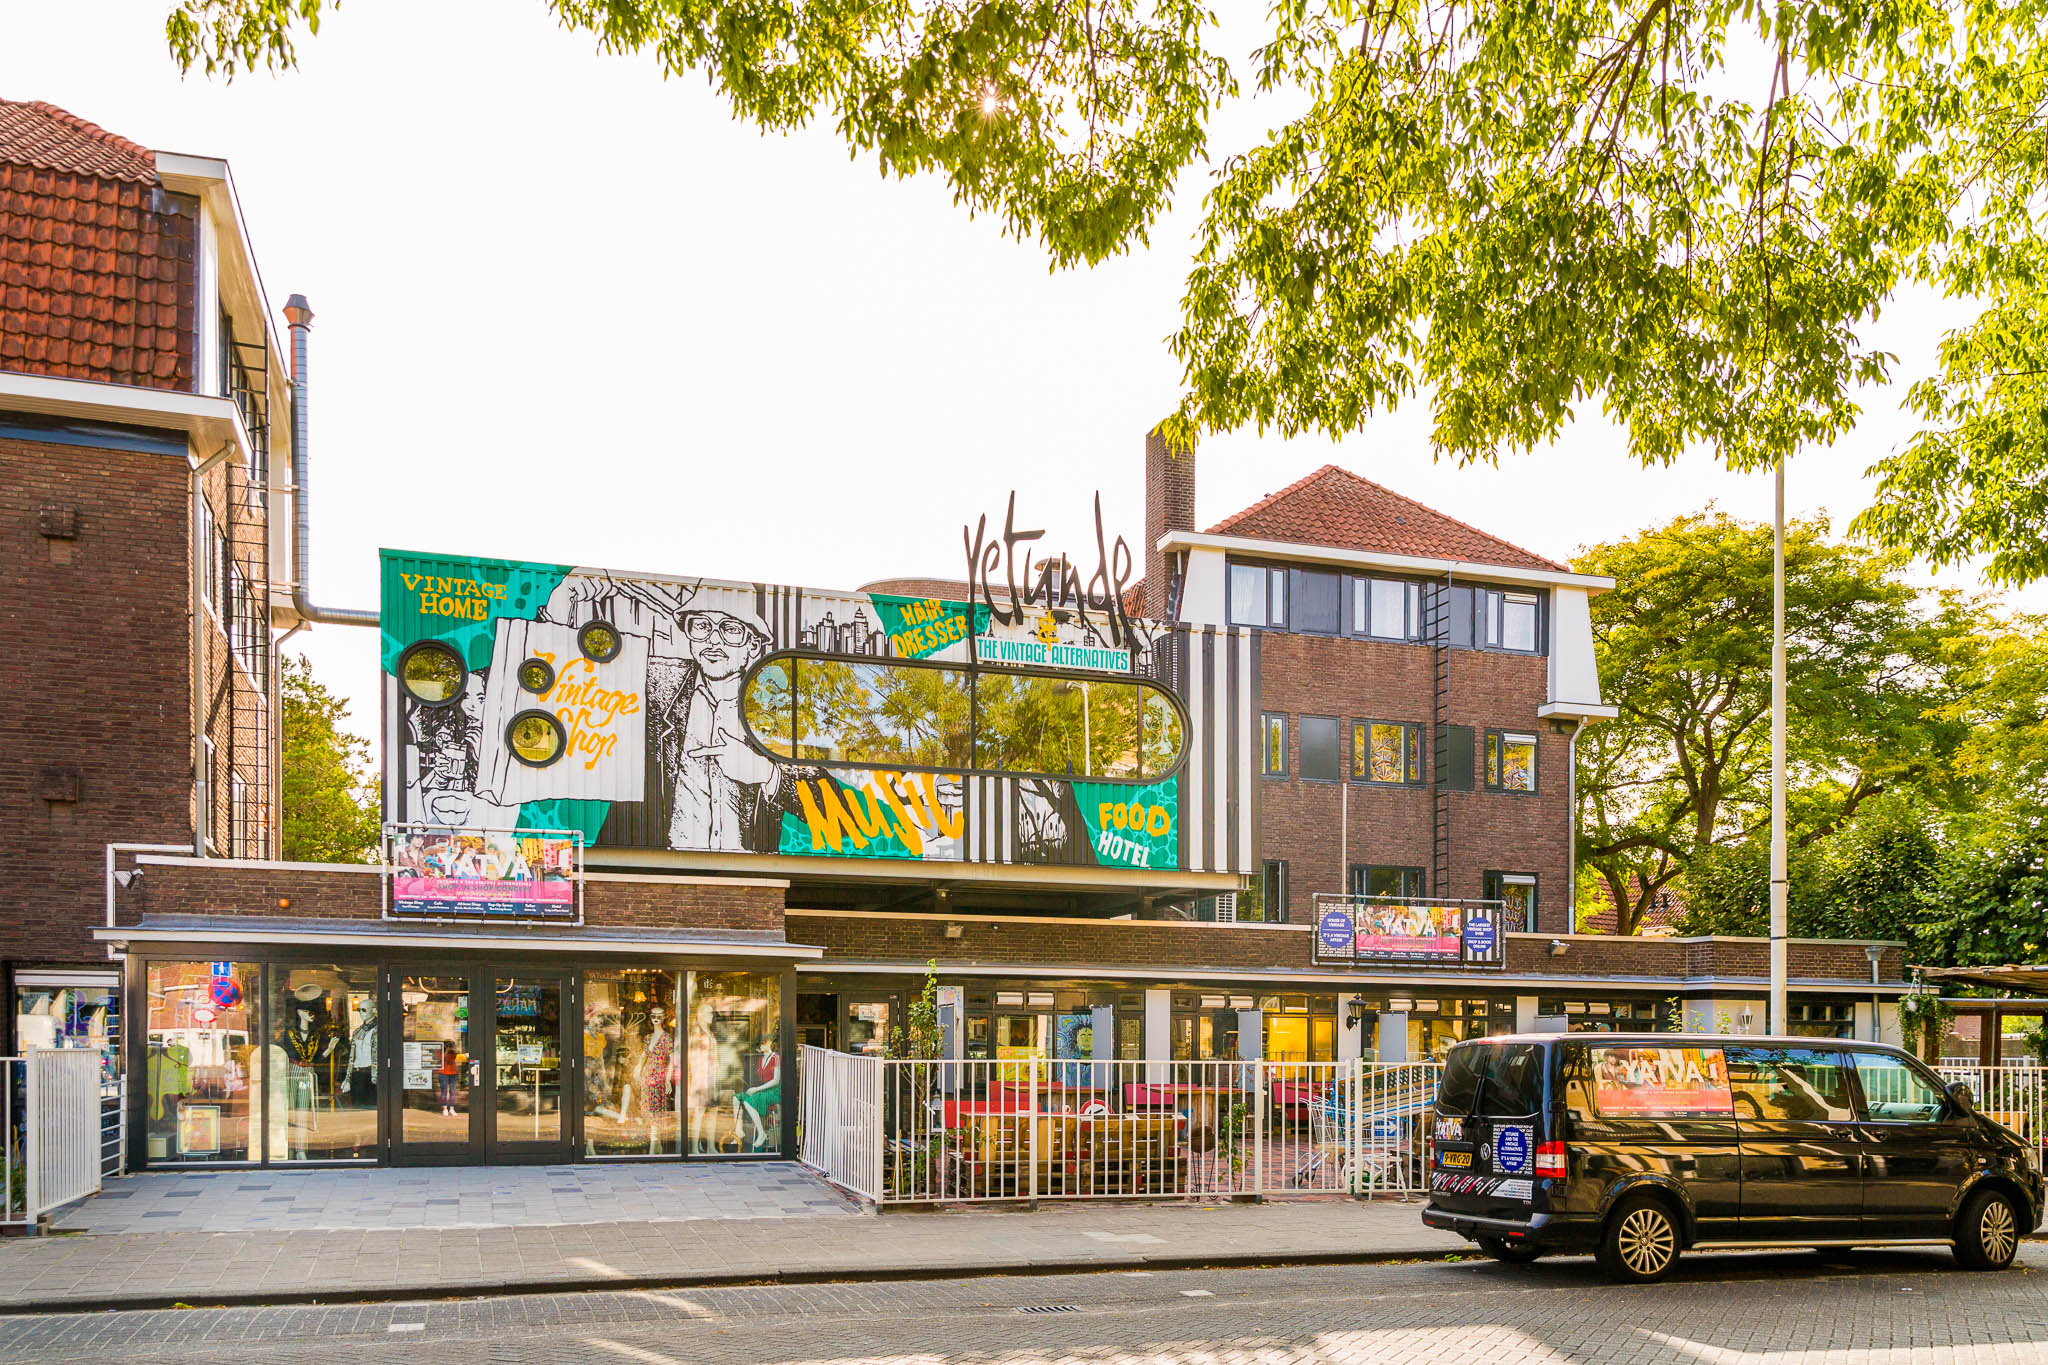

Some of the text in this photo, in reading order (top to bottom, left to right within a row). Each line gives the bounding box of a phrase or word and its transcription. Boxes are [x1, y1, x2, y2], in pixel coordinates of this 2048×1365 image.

[400, 573, 507, 600] VINTAGE
[419, 593, 487, 621] HOME
[900, 599, 945, 626] HAIR
[891, 615, 969, 658] DRESSER
[977, 639, 1128, 670] THE VINTAGE ALTERNATIVES
[1099, 802, 1171, 837] FOOD
[1098, 831, 1151, 869] HOTEL
[1619, 1059, 1705, 1085] YATVA
